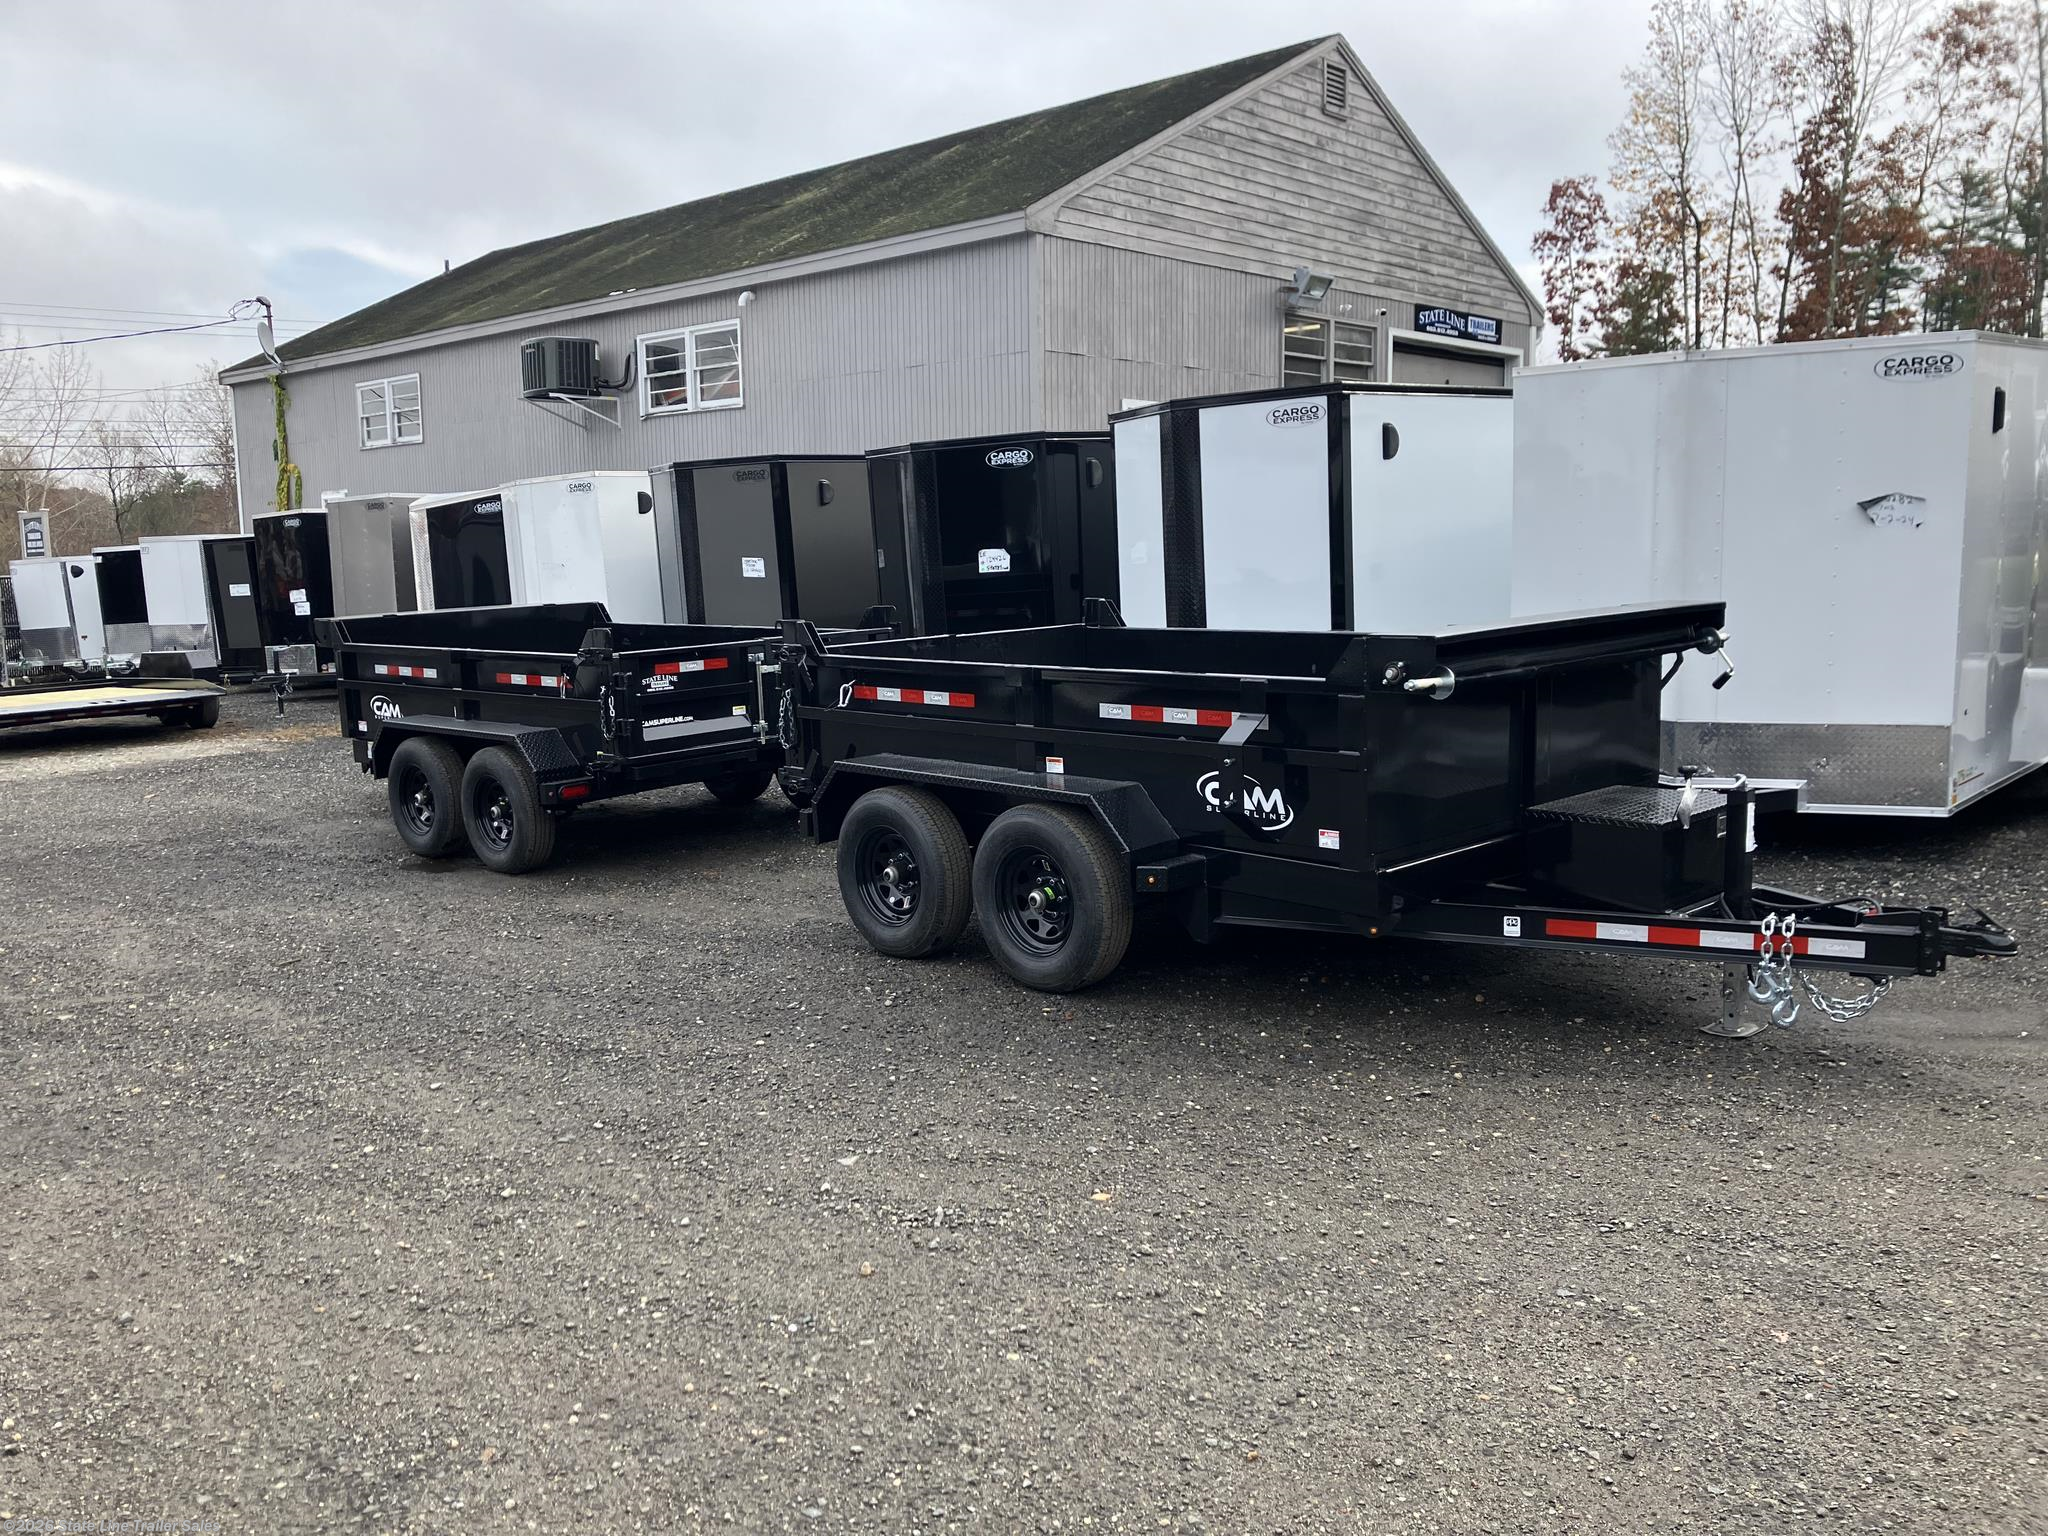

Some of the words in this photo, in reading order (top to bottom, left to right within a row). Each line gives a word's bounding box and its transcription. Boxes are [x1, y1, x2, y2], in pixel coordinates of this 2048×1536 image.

[1419, 309, 1445, 324] STATE
[1446, 310, 1466, 331] LINE
[1470, 318, 1495, 332] TRAILERS
[1884, 354, 1954, 369] CARGO
[1884, 364, 1953, 377] EXPRESS
[1272, 405, 1319, 418] CARGO
[1273, 413, 1320, 424] EXPRESS
[990, 450, 1029, 460] CARGO
[991, 457, 1029, 465] EXPRESS
[477, 501, 501, 509] CARGO
[641, 675, 661, 685] STATE
[661, 674, 679, 682] LINE
[374, 701, 401, 719] CAM
[1173, 712, 1188, 720] CAM
